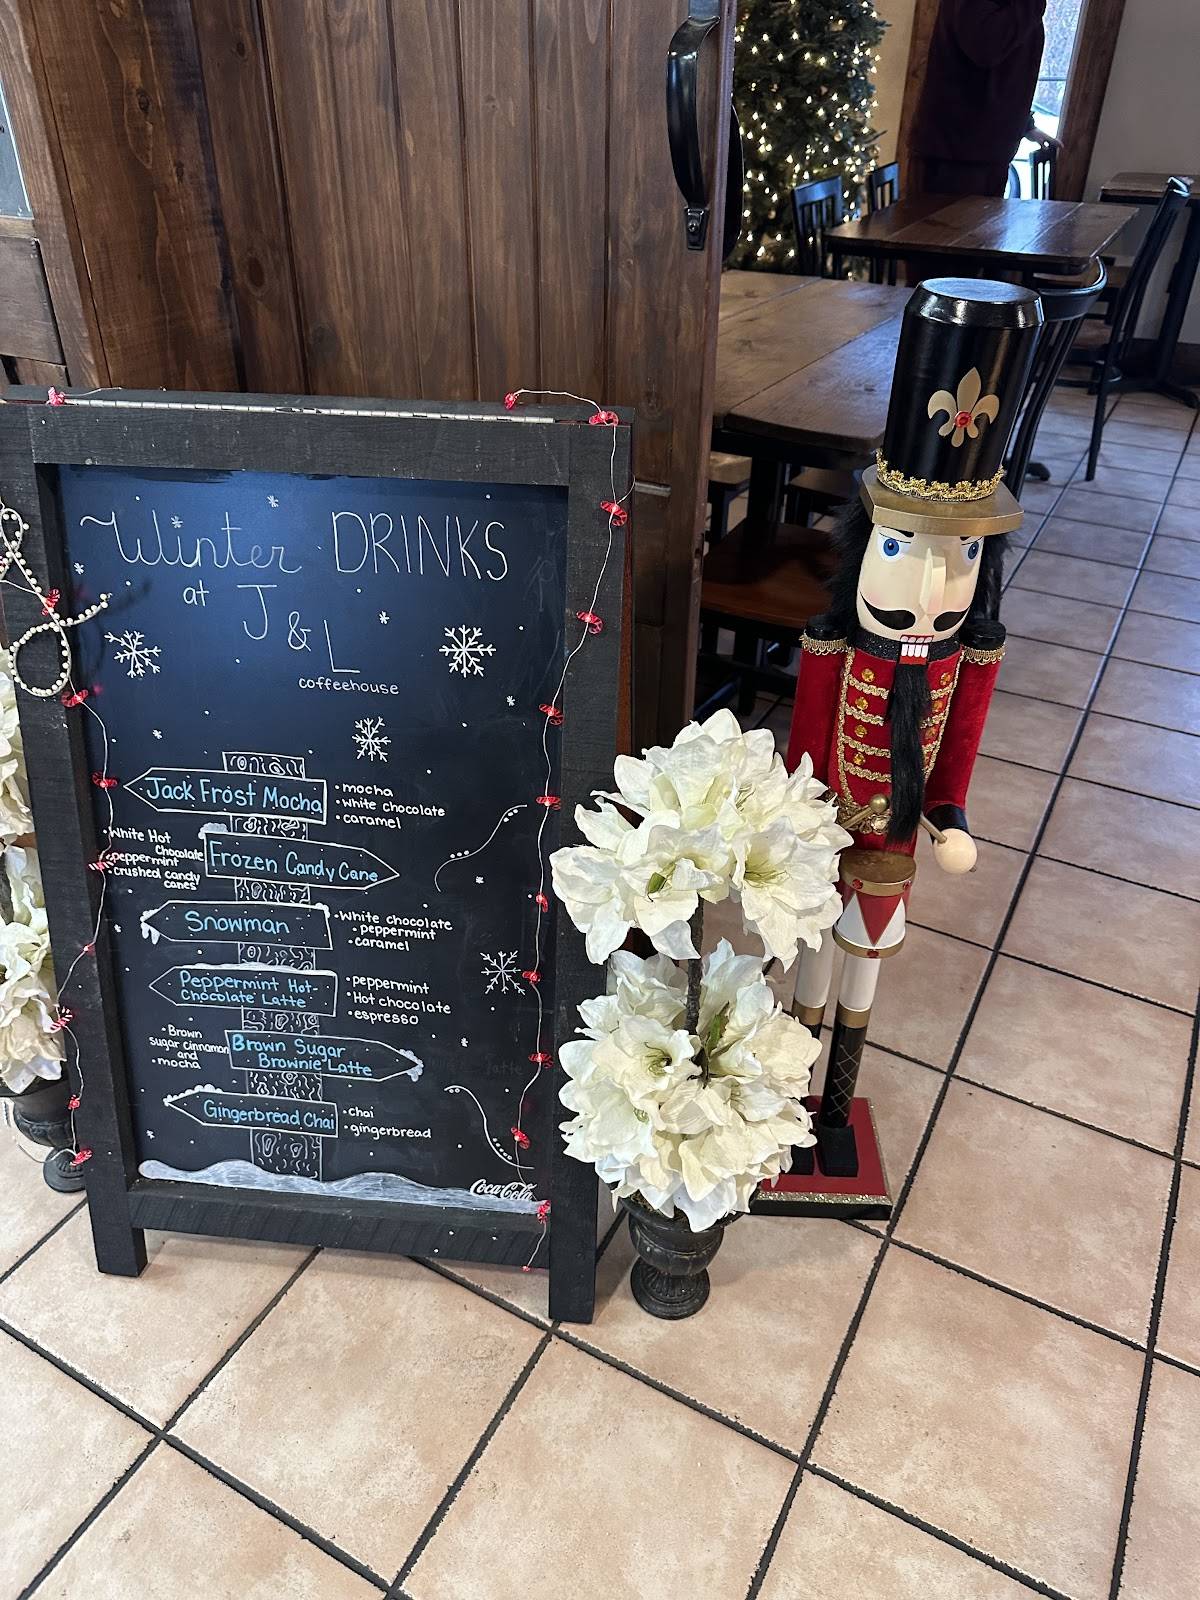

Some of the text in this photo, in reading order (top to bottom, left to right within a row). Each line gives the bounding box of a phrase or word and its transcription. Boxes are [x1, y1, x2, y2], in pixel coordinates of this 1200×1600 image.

[80, 510, 509, 581] Winter DRINKS
[182, 579, 361, 673] at J & L
[298, 675, 400, 696] coffeehouse
[145, 777, 323, 814] Jack Frost Mocha
[342, 783, 393, 797] mocha
[382, 801, 446, 817] chocolate
[343, 814, 402, 829] caramel
[148, 829, 171, 844] Hot
[111, 852, 180, 867] peppermint
[209, 840, 379, 883] Frozen Candy Cane
[113, 867, 201, 885] crushed candy
[164, 880, 198, 891] canes
[184, 910, 290, 934] Snowman
[386, 914, 453, 931] chocolate
[360, 924, 437, 940] peppermint
[354, 937, 410, 951] caramel
[179, 970, 280, 992] Peppermint
[352, 975, 430, 995] peppermint
[181, 989, 306, 1008] Chocolate Latte
[353, 991, 452, 1014] Hot chocolate
[354, 1010, 419, 1025] espresso
[168, 1024, 203, 1039] Brown
[149, 1036, 179, 1051] sugar
[232, 1034, 346, 1062] Brown Sugar
[158, 1057, 201, 1069] mocha
[177, 1049, 199, 1061] and
[259, 1053, 373, 1077] Brownie Latte
[204, 1099, 335, 1130] Gingerbread Chai
[350, 1122, 432, 1140] gingerbread
